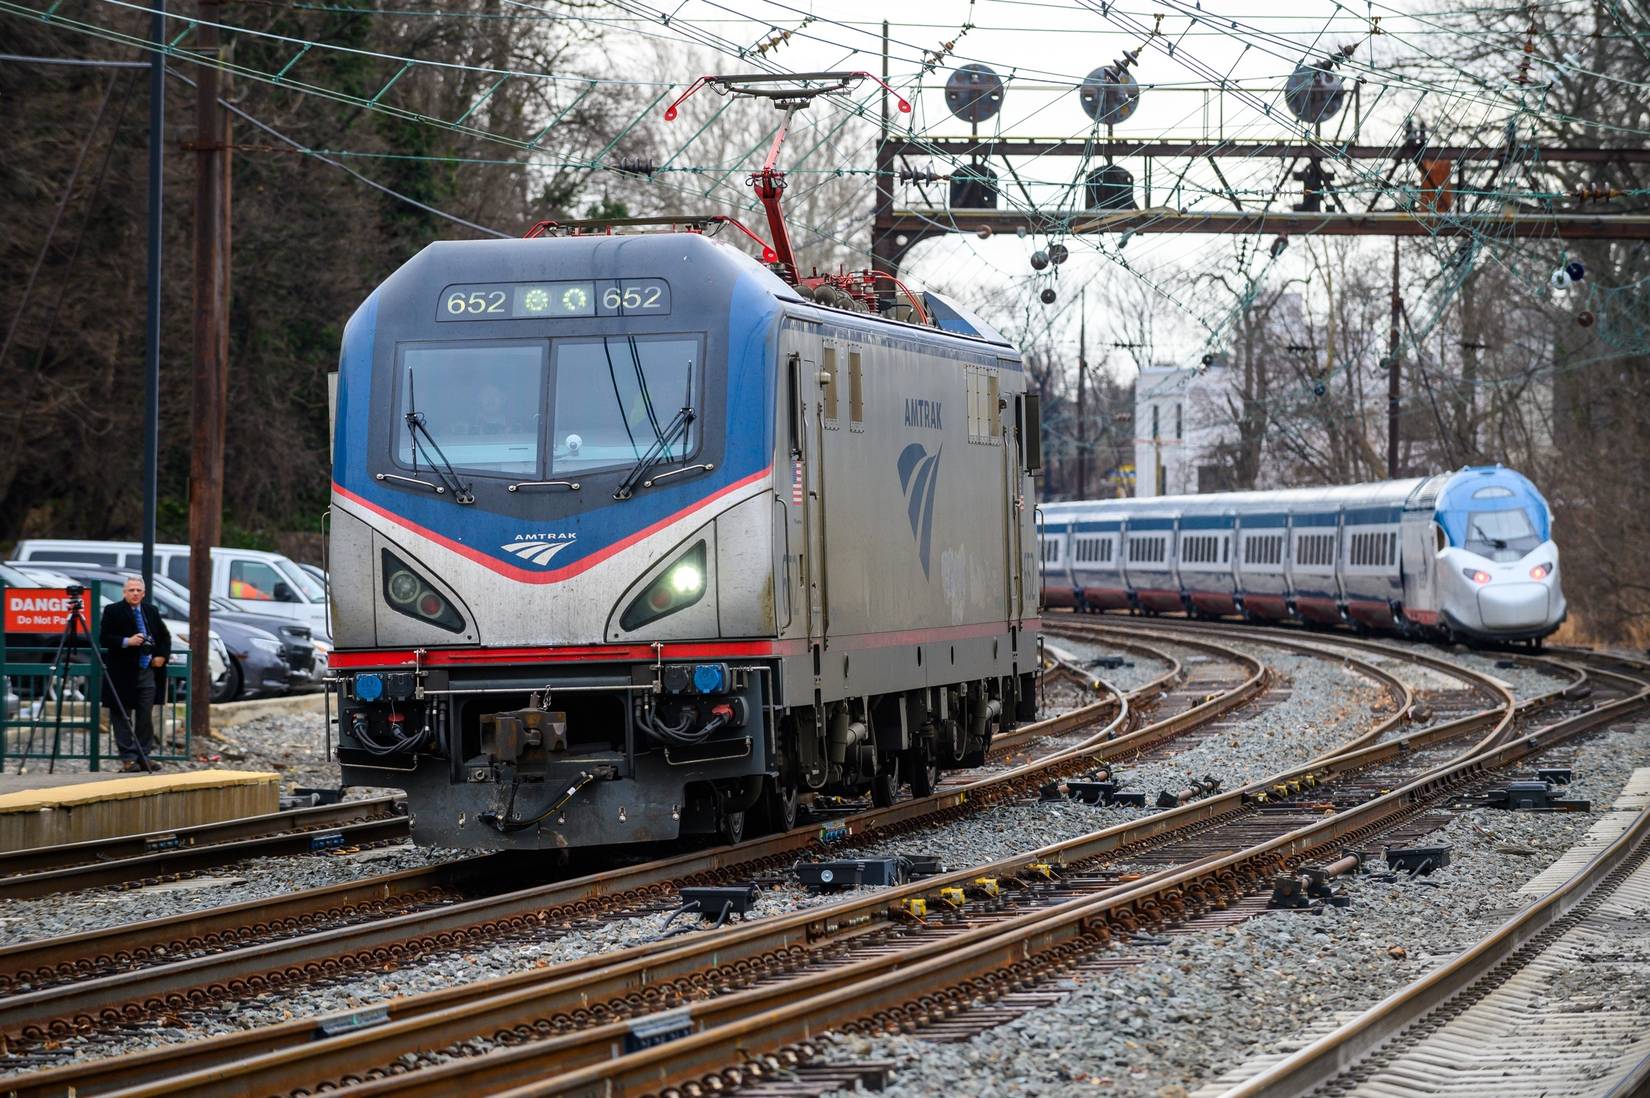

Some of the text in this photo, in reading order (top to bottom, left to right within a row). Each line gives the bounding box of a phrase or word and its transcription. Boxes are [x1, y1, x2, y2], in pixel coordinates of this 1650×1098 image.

[447, 291, 506, 314] 652
[603, 286, 662, 309] 652
[904, 398, 943, 430] AMTRAK
[514, 532, 577, 540] AMTRAK
[10, 597, 85, 612] DANGE
[16, 615, 32, 625] Do
[34, 615, 52, 625] Not
